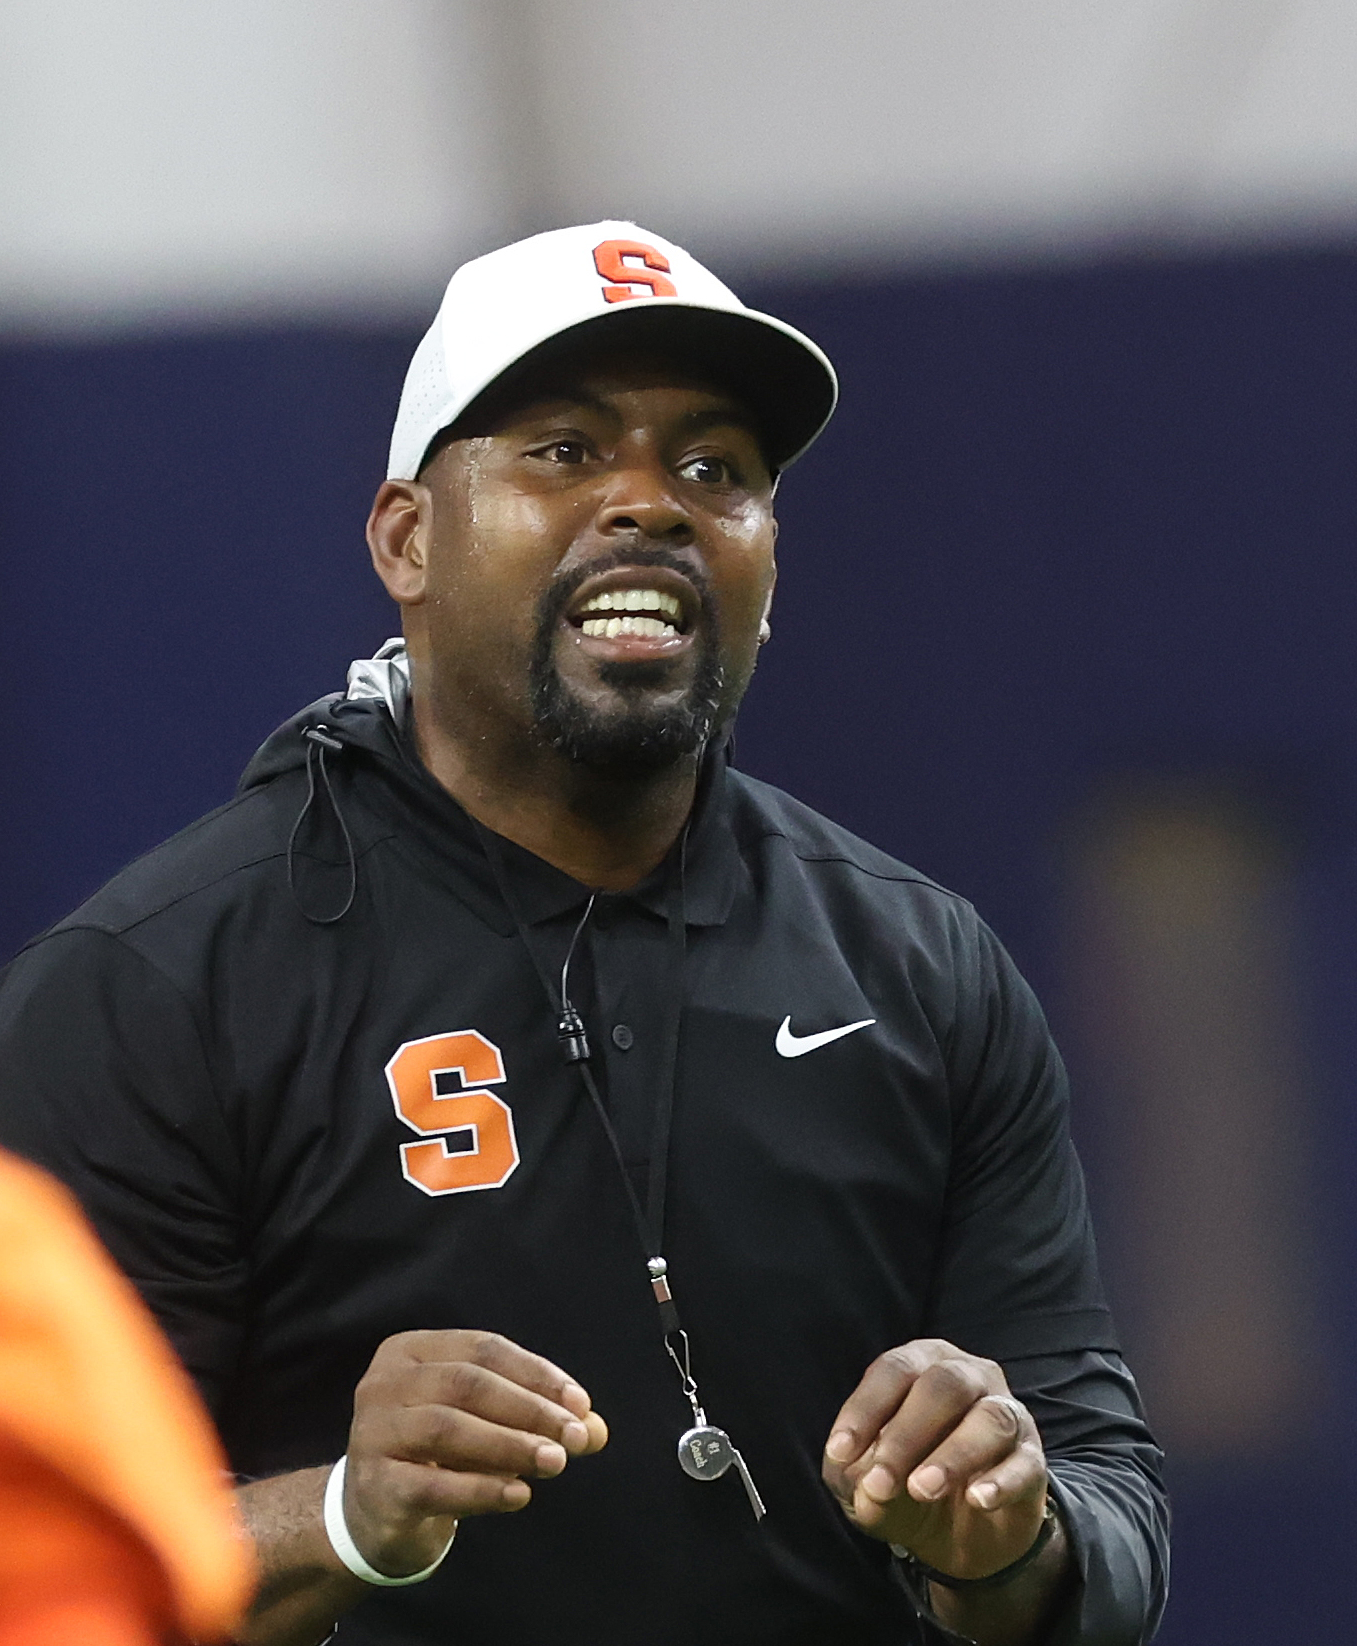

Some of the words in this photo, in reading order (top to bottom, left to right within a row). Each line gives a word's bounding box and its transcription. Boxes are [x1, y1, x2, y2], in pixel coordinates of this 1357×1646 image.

[593, 240, 677, 304] S
[385, 1029, 521, 1196] S
[690, 1440, 708, 1469] Coach
